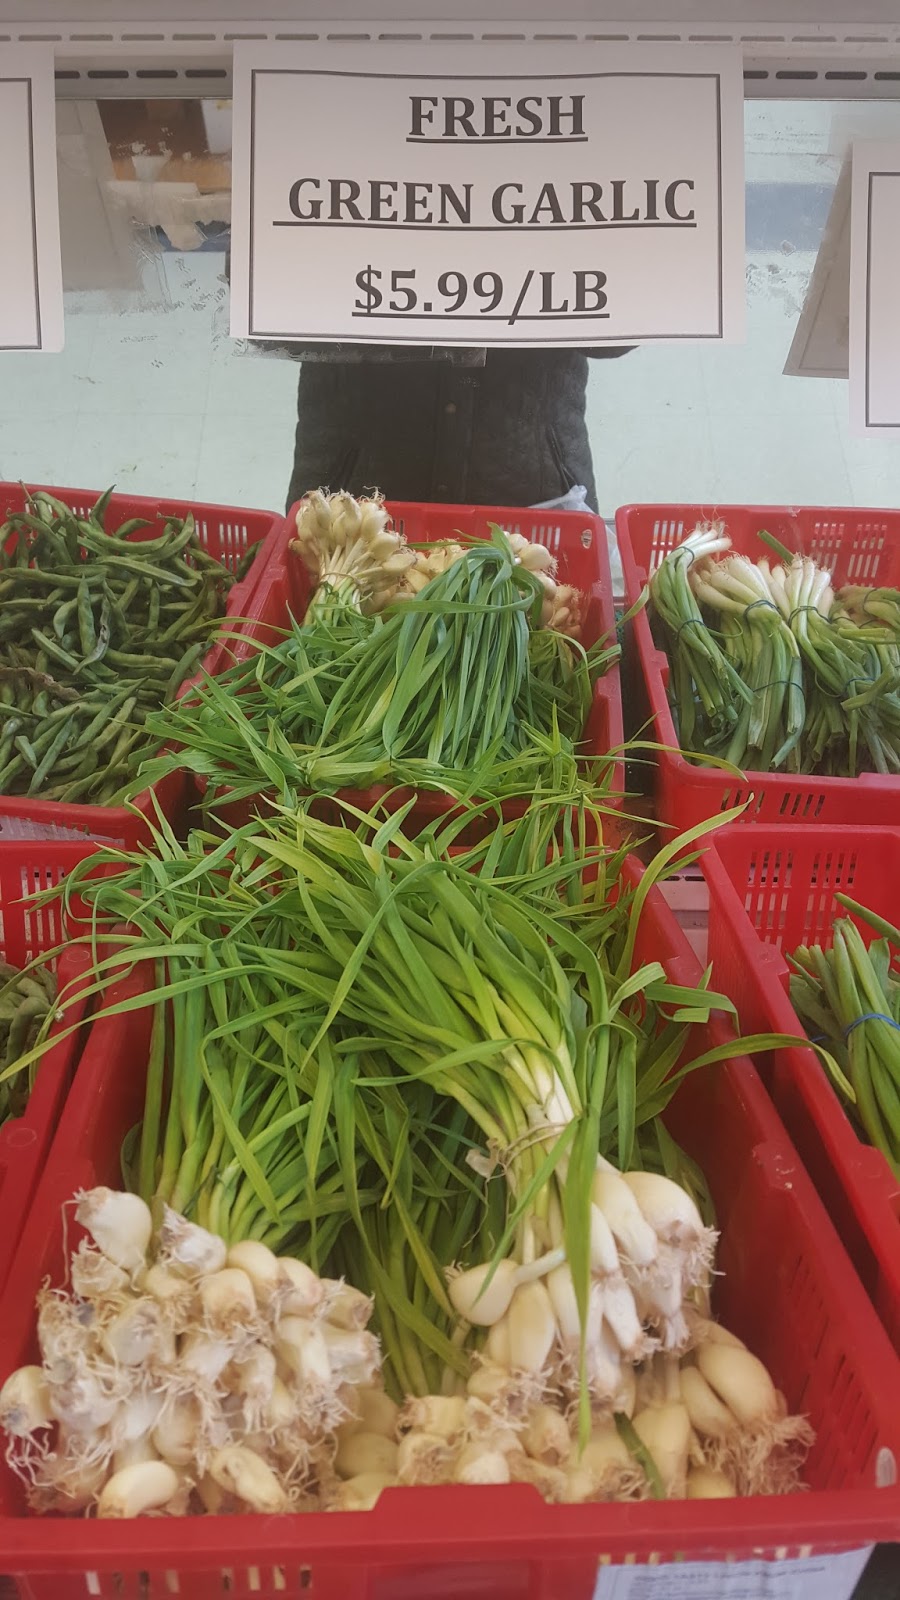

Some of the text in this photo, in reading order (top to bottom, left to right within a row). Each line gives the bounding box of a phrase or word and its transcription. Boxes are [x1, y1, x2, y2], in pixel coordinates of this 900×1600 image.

[408, 95, 586, 136] FRESH
[288, 177, 696, 224] GREEN GARLIC
[354, 264, 608, 325] $5.99/LB
